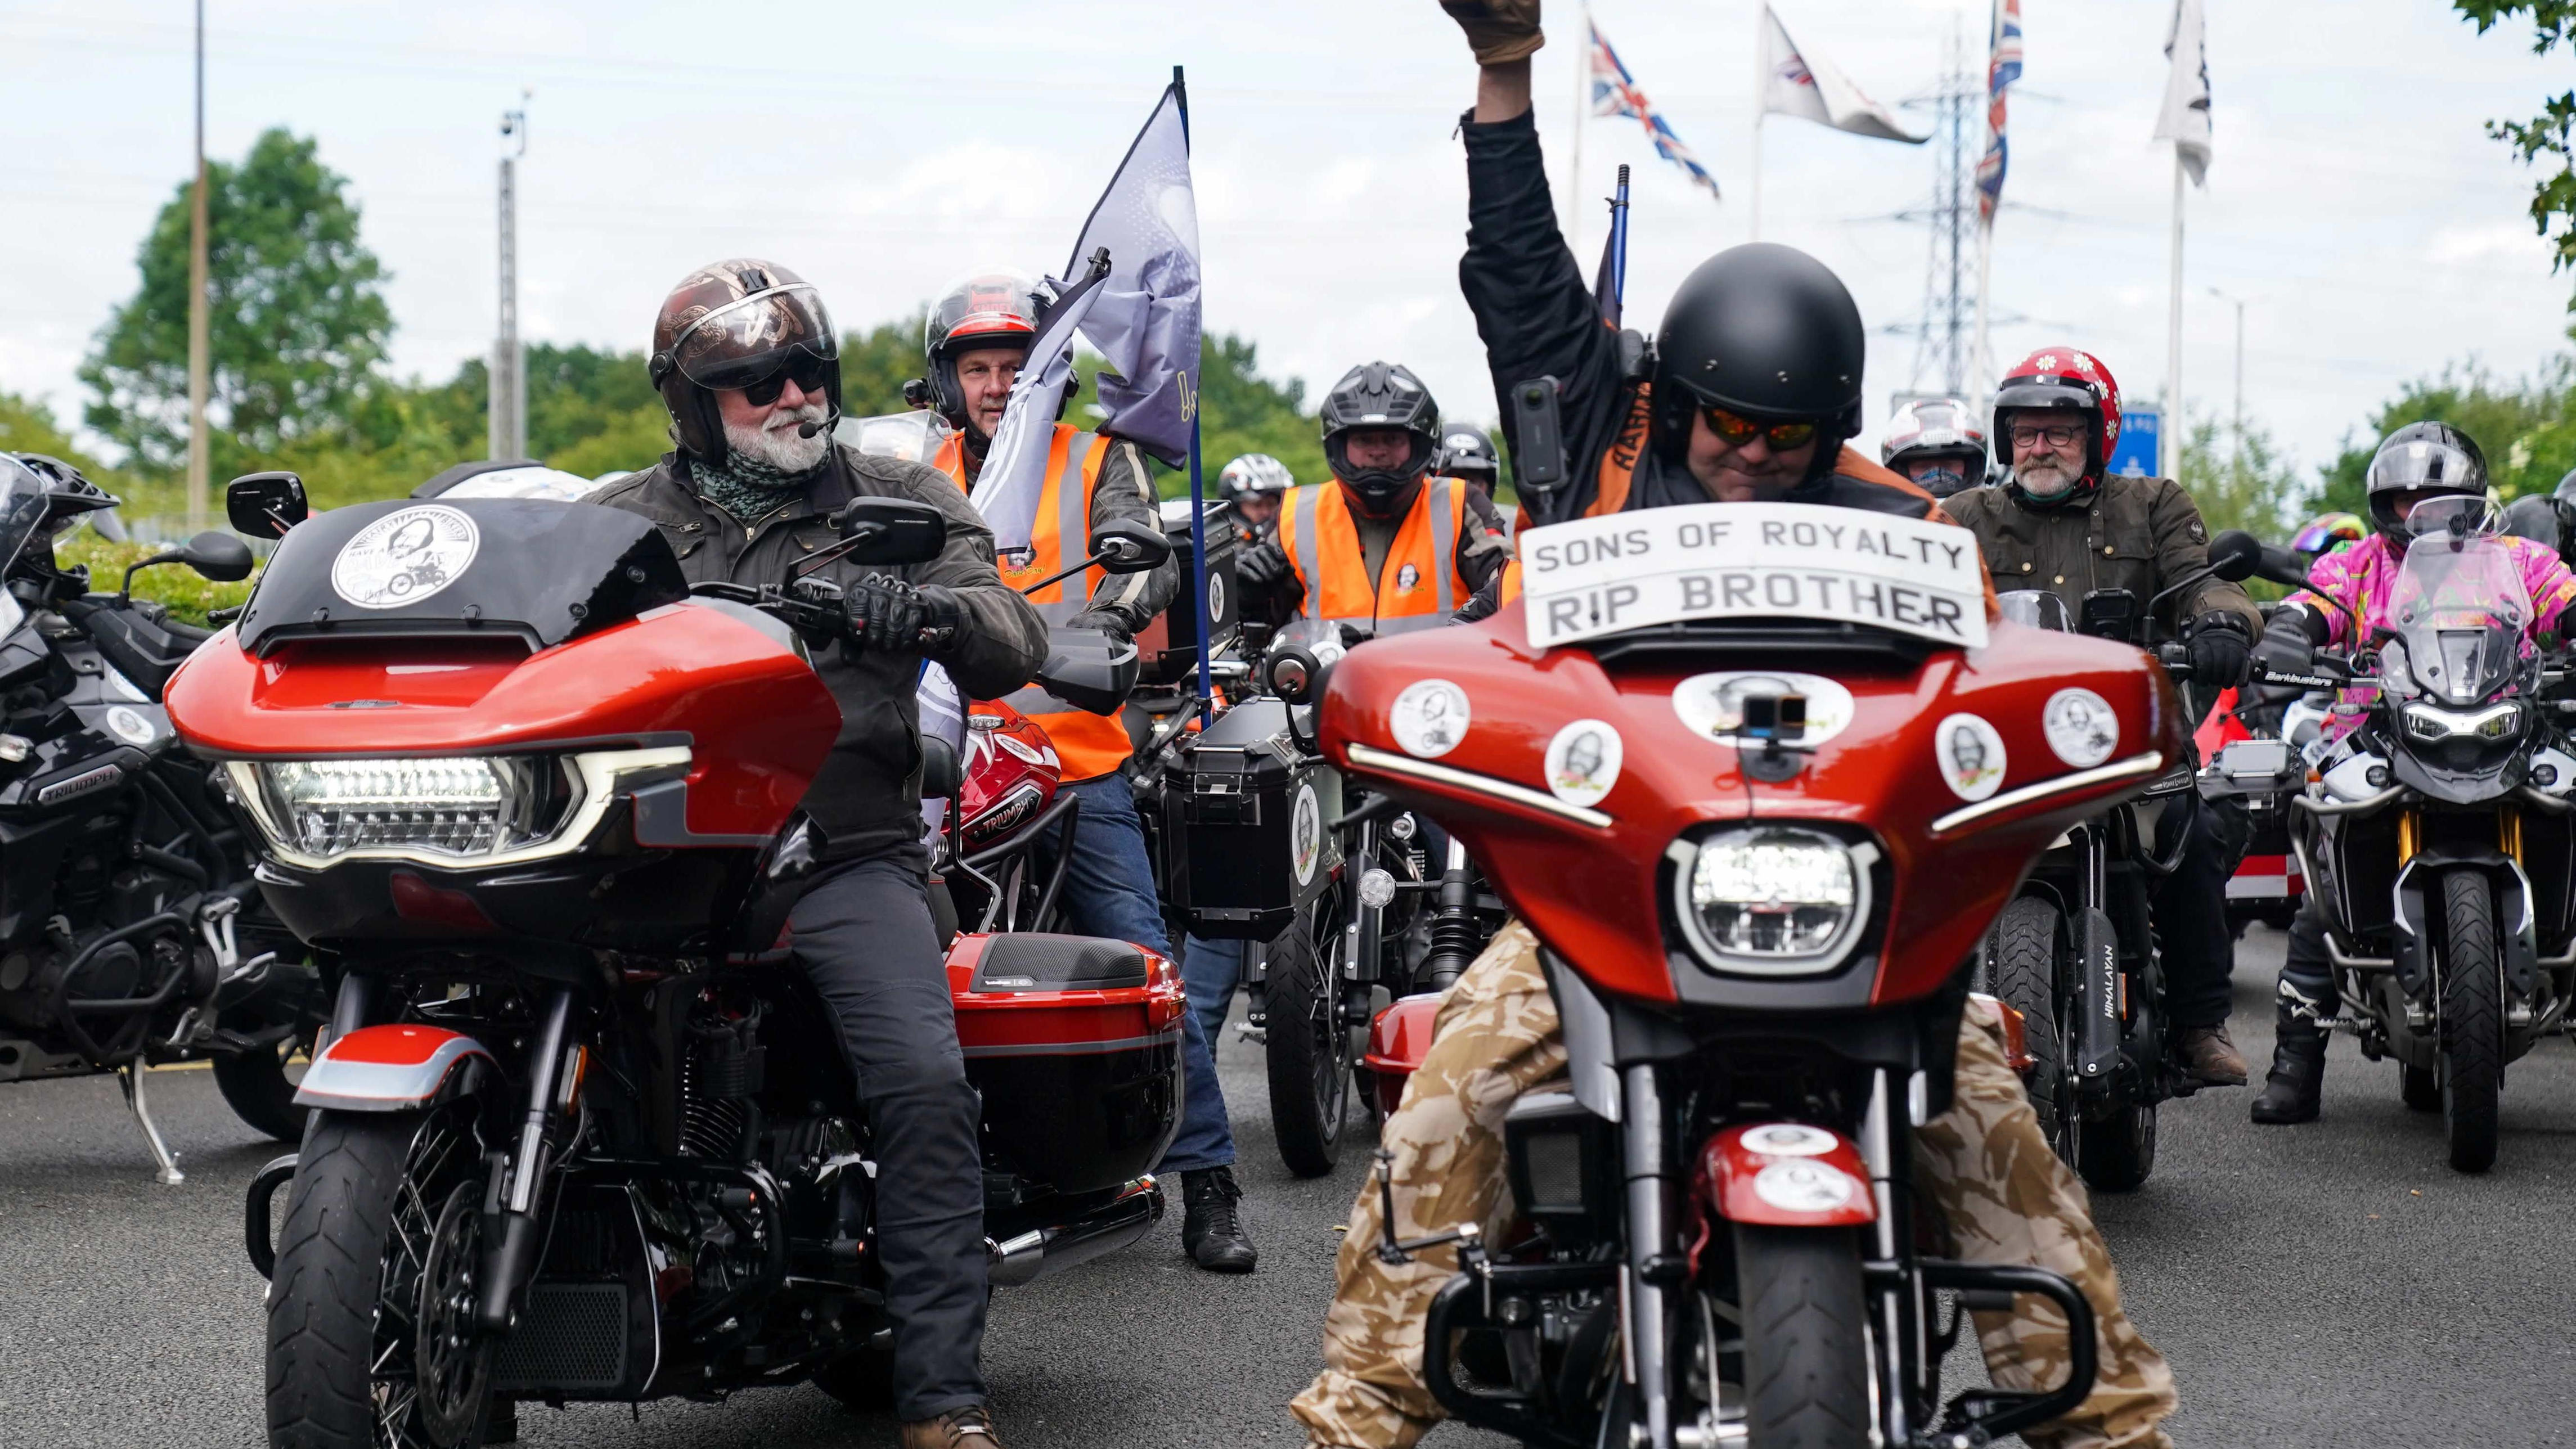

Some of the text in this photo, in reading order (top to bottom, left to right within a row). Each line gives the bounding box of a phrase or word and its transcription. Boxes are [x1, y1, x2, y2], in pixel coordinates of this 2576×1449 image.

[349, 548, 374, 558] HAVE
[1534, 520, 1966, 573] SONS OF ROYALTY
[1548, 573, 1963, 637] RIP BROTHER
[2264, 670, 2334, 687] Barkbusters
[45, 771, 113, 802] TRIUMPH
[983, 798, 1029, 834] TRIUMPH
[2104, 944, 2114, 1019] HIMALAYAN
